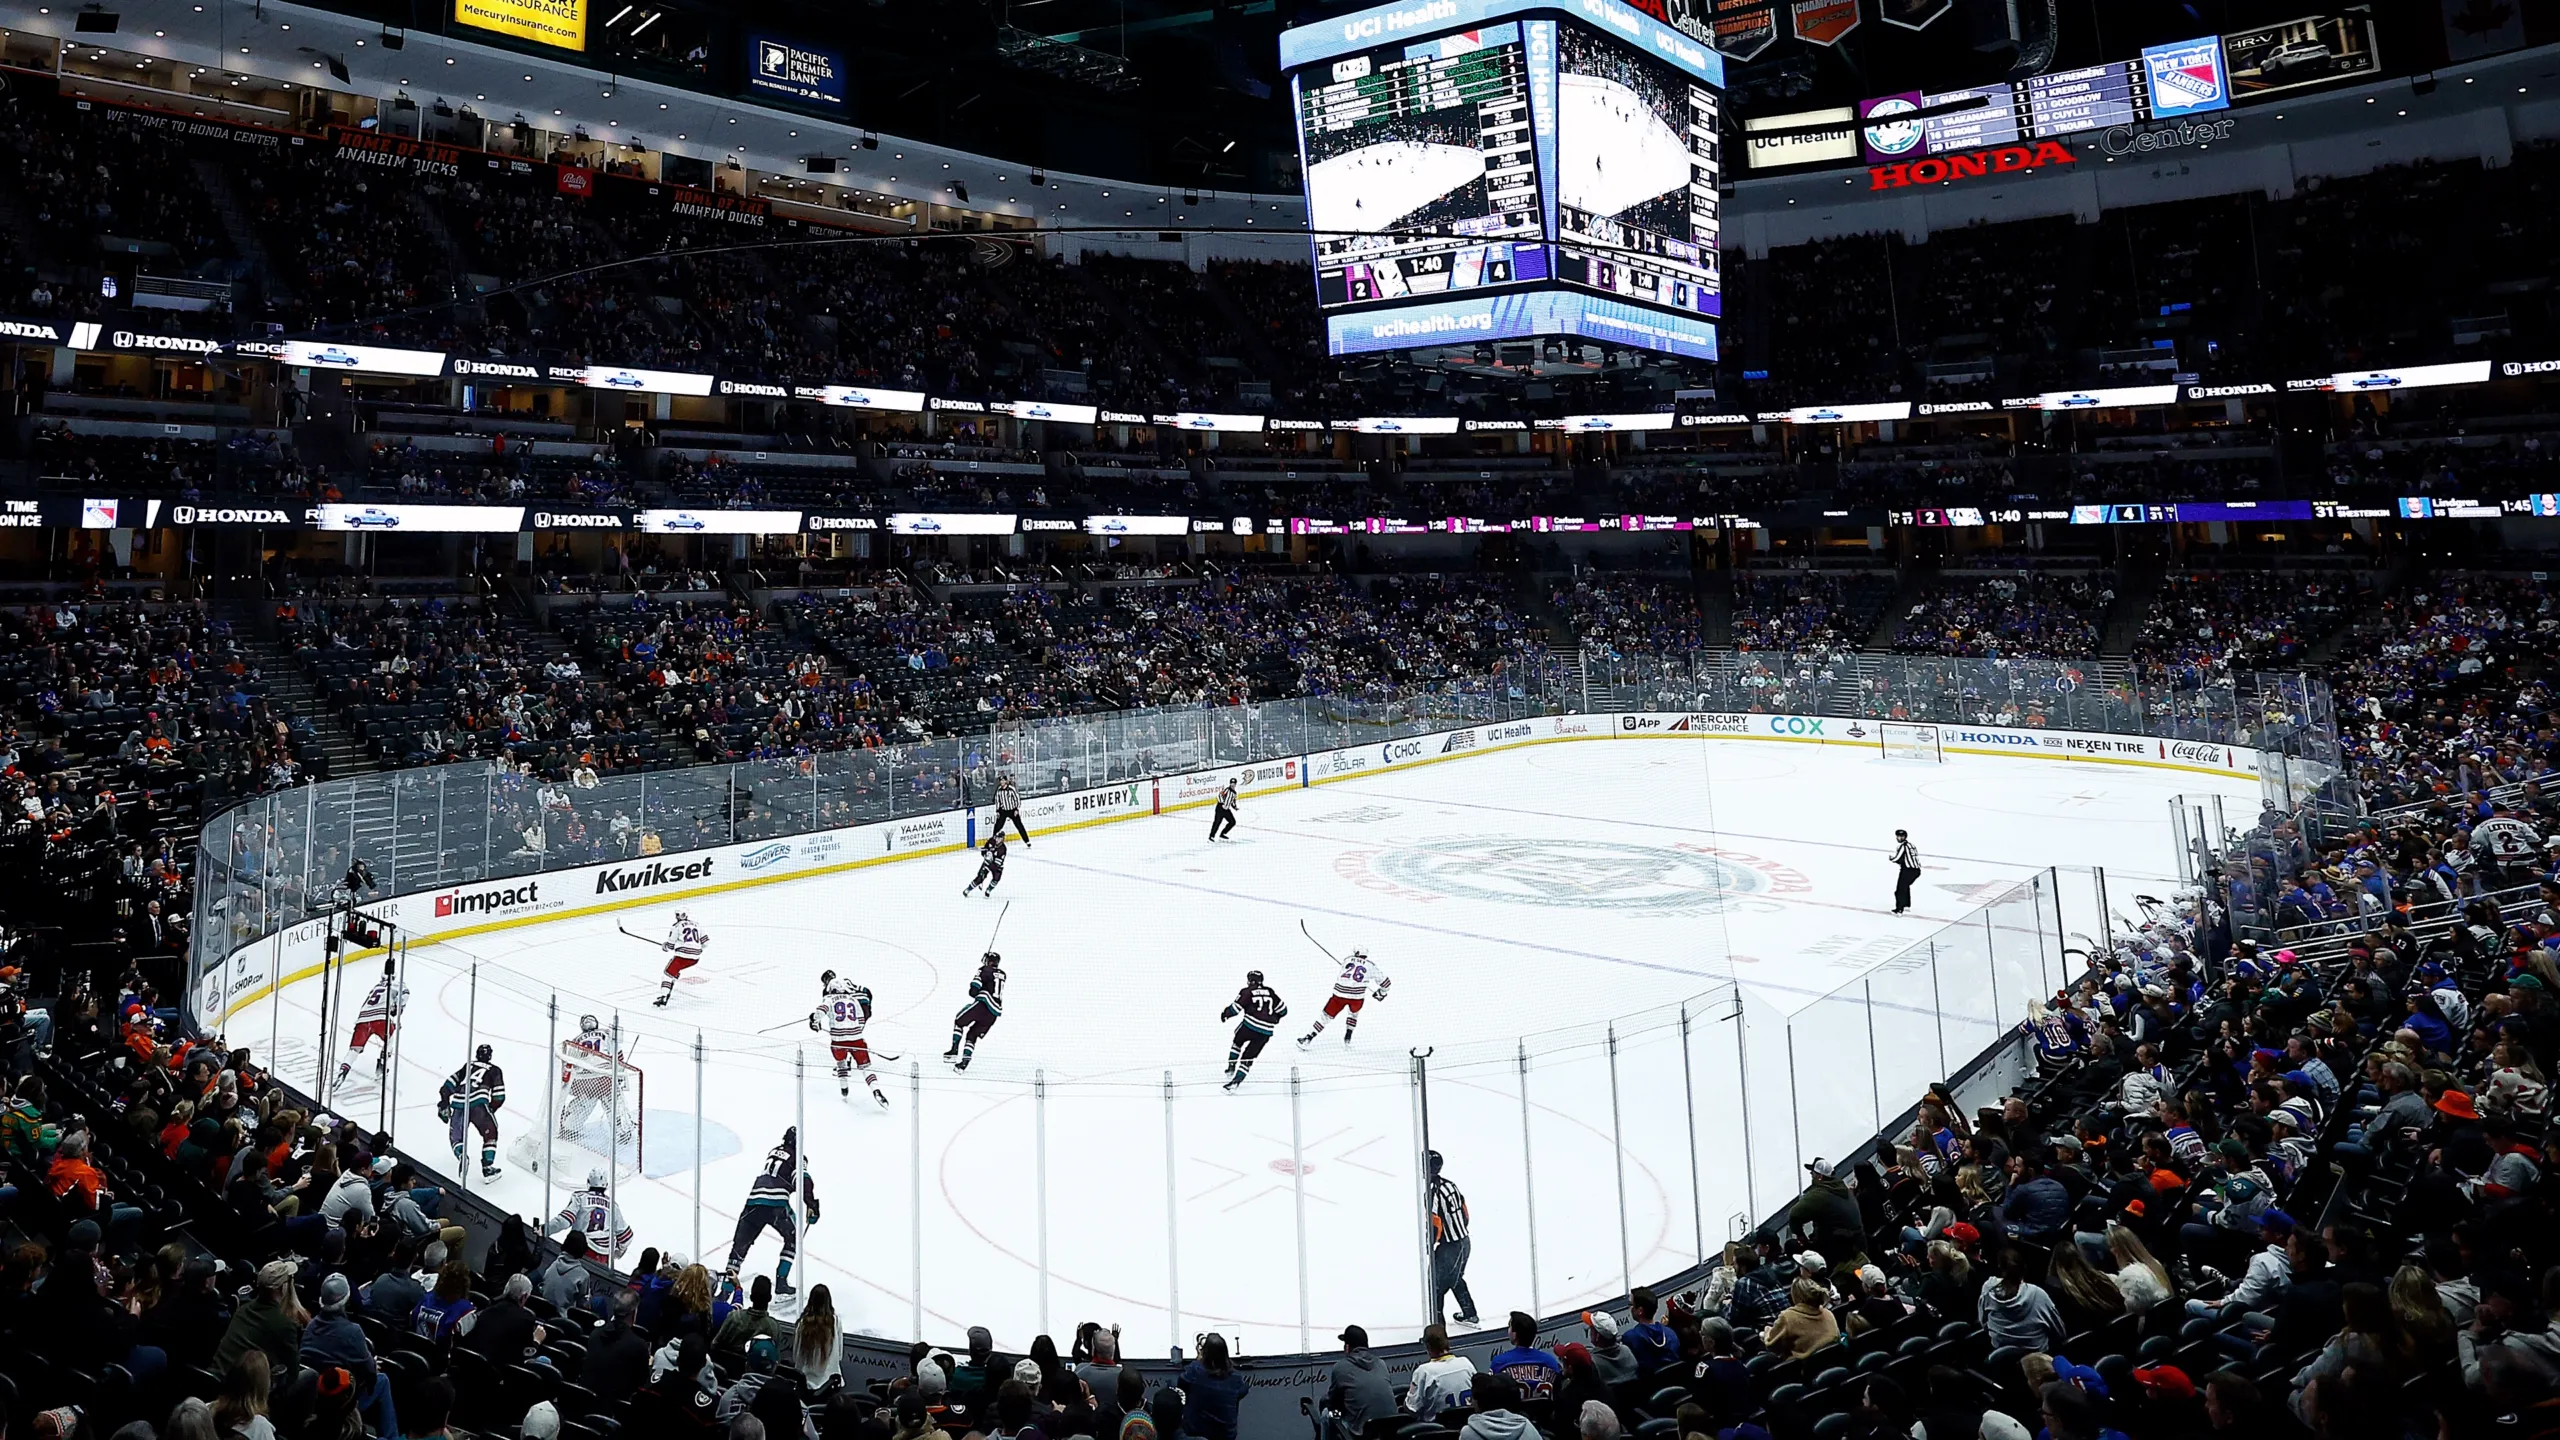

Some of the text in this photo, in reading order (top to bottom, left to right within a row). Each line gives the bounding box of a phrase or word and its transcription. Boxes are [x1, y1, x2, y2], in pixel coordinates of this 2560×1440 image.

[464, 4, 577, 39] MercuryInsurance.com
[1344, 0, 1457, 41] UCI Health
[1583, 0, 1604, 17] UCI
[1606, 3, 1641, 36] Health
[2228, 33, 2273, 50] HR-V
[790, 49, 829, 67] PACIFIC
[1656, 30, 1706, 71] UCI Health
[790, 60, 834, 79] PREMIER
[2155, 52, 2211, 72] NEW YORK
[790, 70, 818, 86] BANK
[1530, 23, 1554, 136] UCI Health
[2032, 62, 2137, 87] 13 LAFRENIÈRE 3
[2049, 82, 2090, 97] KREIDER
[2131, 74, 2139, 82] 2
[2164, 70, 2215, 99] RANGERS
[1924, 81, 2024, 107] 7 GUDAS 5
[2017, 94, 2026, 102] 2
[2035, 86, 2141, 111] 21 GOODROW 2
[2020, 105, 2027, 113] 1
[2052, 107, 2091, 120] CUYLLE
[2135, 98, 2143, 107] 2
[1943, 124, 1981, 138] STROME
[2022, 117, 2028, 126] 1
[2053, 119, 2095, 133] TROUBA
[2138, 110, 2145, 119] 1
[172, 119, 279, 147] TO HONDA CENTER
[1755, 127, 1848, 150] UCI Health
[1945, 129, 2030, 150] LEASON 1
[2100, 118, 2235, 156] Center
[339, 133, 390, 150] HOME
[398, 143, 416, 157] OF
[335, 146, 407, 169] ANAHEIM
[1868, 139, 2078, 191] HONDA
[728, 211, 765, 227] DUCKS
[1410, 256, 1443, 274] 1:40
[1493, 263, 1506, 279] 4
[1603, 267, 1610, 284] 2
[1638, 272, 1653, 289] 1:40
[1354, 282, 1366, 298] 2
[1678, 287, 1684, 302] 4
[1373, 311, 1493, 339] ucihealth.org
[135, 333, 223, 354] HONDA
[471, 361, 540, 378] HONDA
[734, 383, 788, 397] HONDA
[2205, 382, 2277, 397] HONDA
[941, 400, 985, 412] HONDA
[1932, 400, 1994, 412] HONDA
[1110, 411, 1147, 424] HONDA
[1280, 419, 1325, 430] HONDA
[1477, 420, 1528, 430] HONDA
[1694, 413, 1750, 425] HONDA
[5, 500, 38, 513] TIME
[2122, 507, 2134, 519] 4
[2315, 505, 2335, 518] 31
[2432, 498, 2479, 511] Lindgren
[2501, 500, 2532, 513] 1:45
[0, 514, 42, 527] ON ICE
[197, 509, 291, 524] HONDA
[552, 515, 622, 528] HONDA
[1692, 517, 1715, 526] 0:41
[1924, 511, 1936, 524] 2
[1989, 510, 2021, 523] 1:40
[2149, 512, 2164, 521] 31
[2336, 509, 2391, 518] SHESTERKIN
[823, 518, 878, 530] HONDA
[1033, 519, 1077, 531] HONDA
[1511, 519, 1531, 529] 0:41
[1599, 518, 1620, 528] 0:41
[1724, 519, 1731, 529] 1
[1690, 714, 1748, 725] MERCURY
[1690, 722, 1749, 732] INSURANCE
[1770, 716, 1825, 736] COX
[1487, 729, 1503, 742] UCI
[1504, 723, 1532, 738] Health
[1960, 731, 2039, 747] HONDA
[1394, 742, 1422, 759] CHOC
[2067, 738, 2112, 754] NEXEN
[2115, 741, 2145, 754] TIRE
[2171, 741, 2220, 764] Coca-Cola
[1333, 751, 1346, 762] OC
[1333, 758, 1365, 772] SOLAR
[2497, 831, 2520, 853] 2
[762, 845, 791, 865] RIVERS
[595, 856, 713, 895] Kwikset
[1673, 841, 1814, 894] HONDA
[452, 880, 538, 915] impact
[681, 927, 701, 943] 20
[2396, 939, 2407, 950] 13
[1341, 962, 1368, 983] 26
[833, 1001, 857, 1022] 93
[1252, 996, 1274, 1015] 77
[2043, 1023, 2072, 1050] 10
[588, 1208, 607, 1232] 8
[1291, 1367, 1329, 1388] Circle
